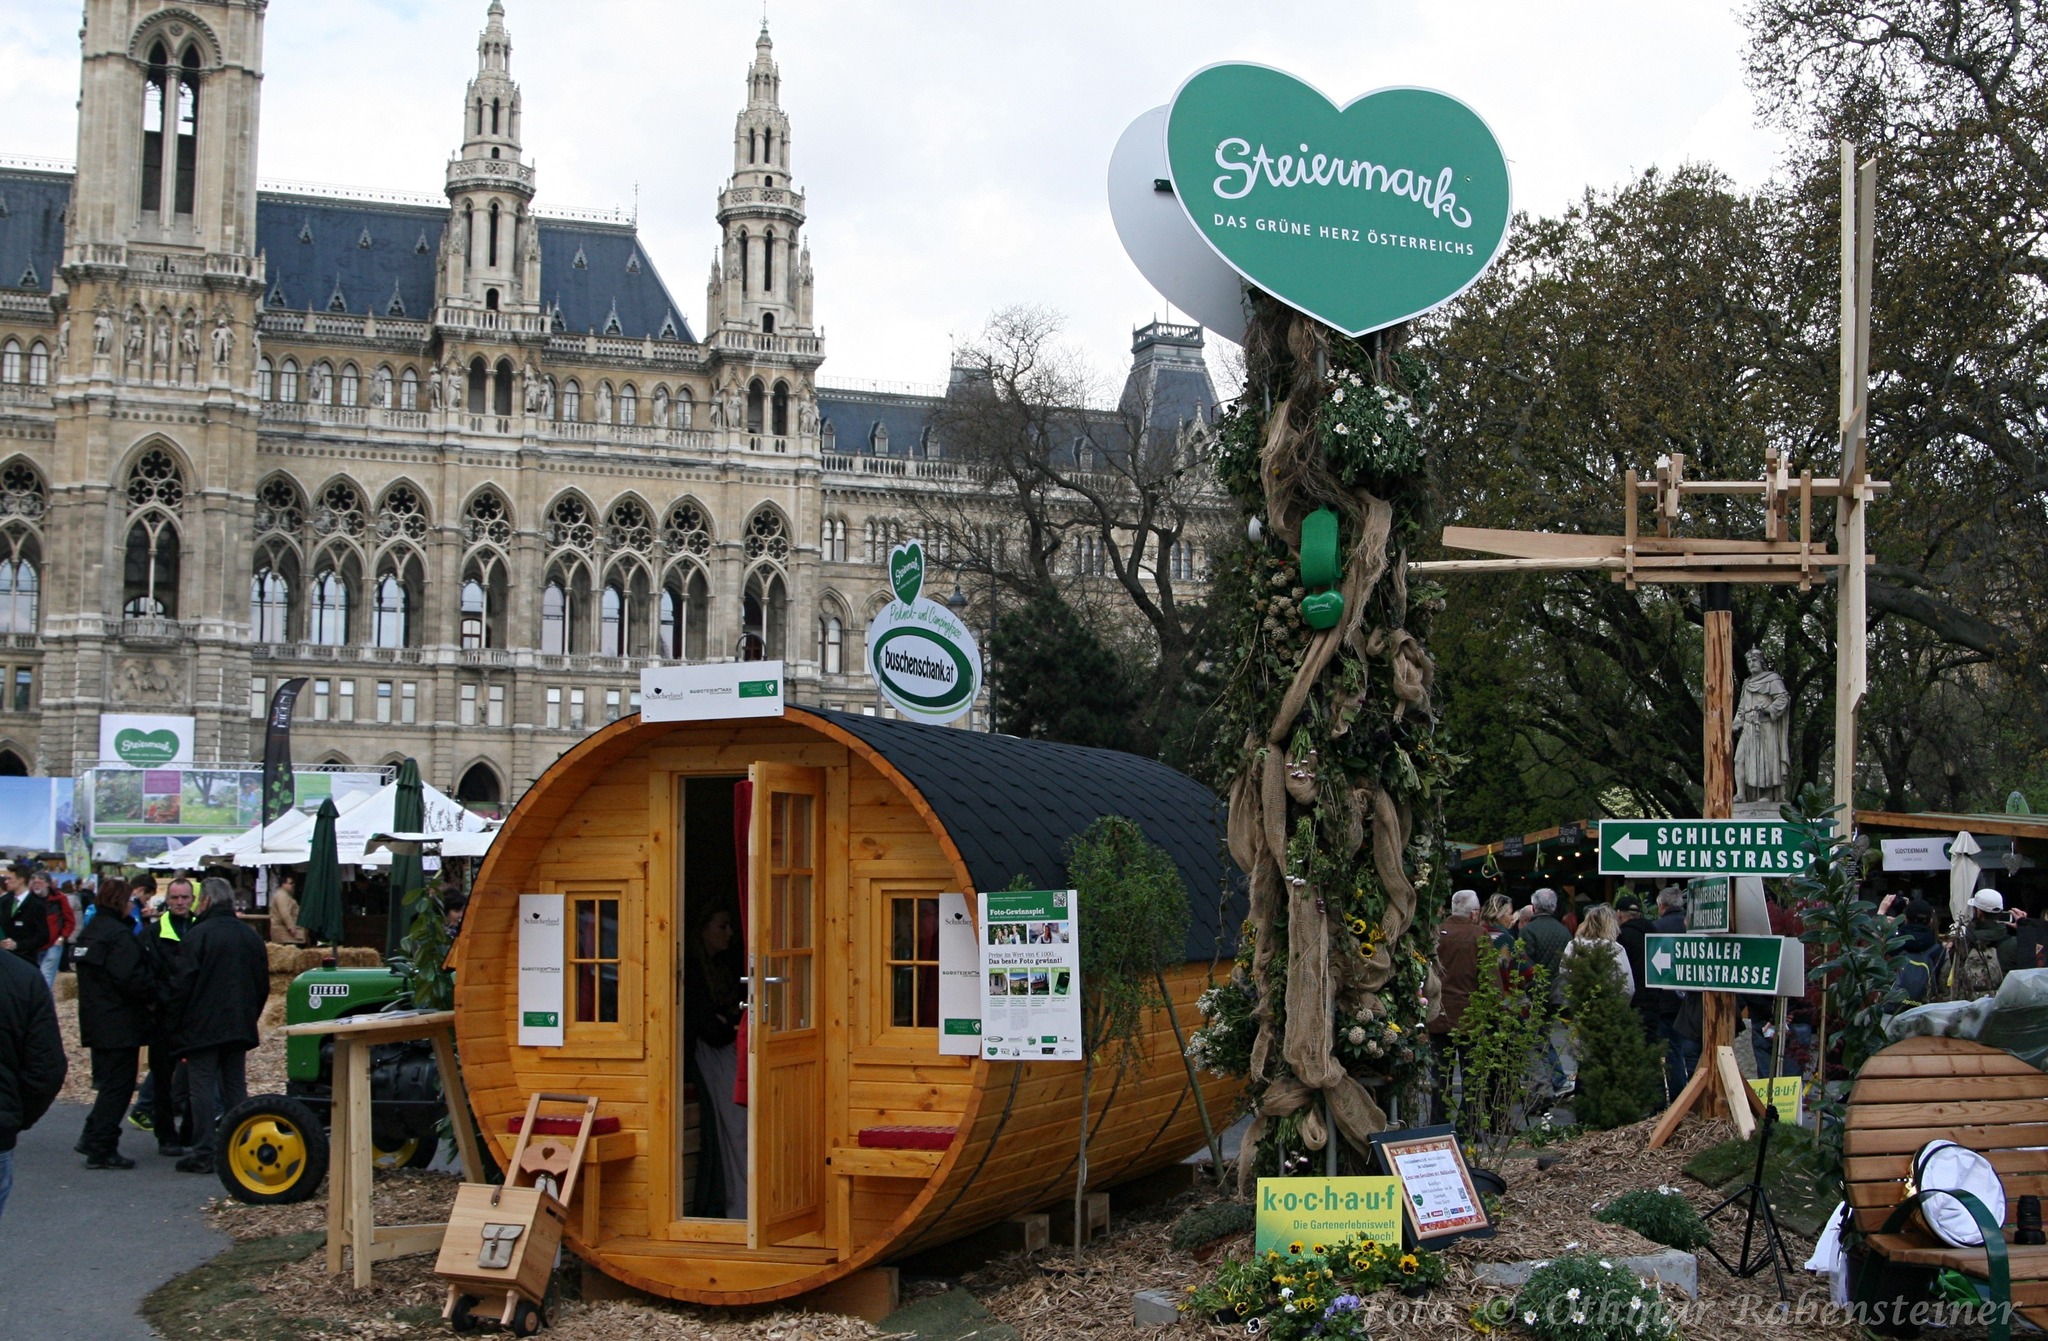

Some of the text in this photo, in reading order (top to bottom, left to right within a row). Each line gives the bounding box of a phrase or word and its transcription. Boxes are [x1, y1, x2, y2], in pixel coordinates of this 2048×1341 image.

[1213, 137, 1473, 228] Steiermark
[1214, 213, 1475, 256] DAS GRÜNE HERZ ÖSTERREICHS
[885, 646, 954, 683] buschenschank.at
[1657, 827, 1783, 845] SCHILCHER
[989, 908, 1045, 916] Foto-Gewinnspiel
[1675, 942, 1742, 960] SAUSALER
[1035, 957, 1063, 966] gewinnt!
[1675, 964, 1770, 985] WEINSTRASSE
[313, 986, 345, 995] DIESEL
[1293, 1219, 1395, 1230] Die Gartenerlebniswelt
